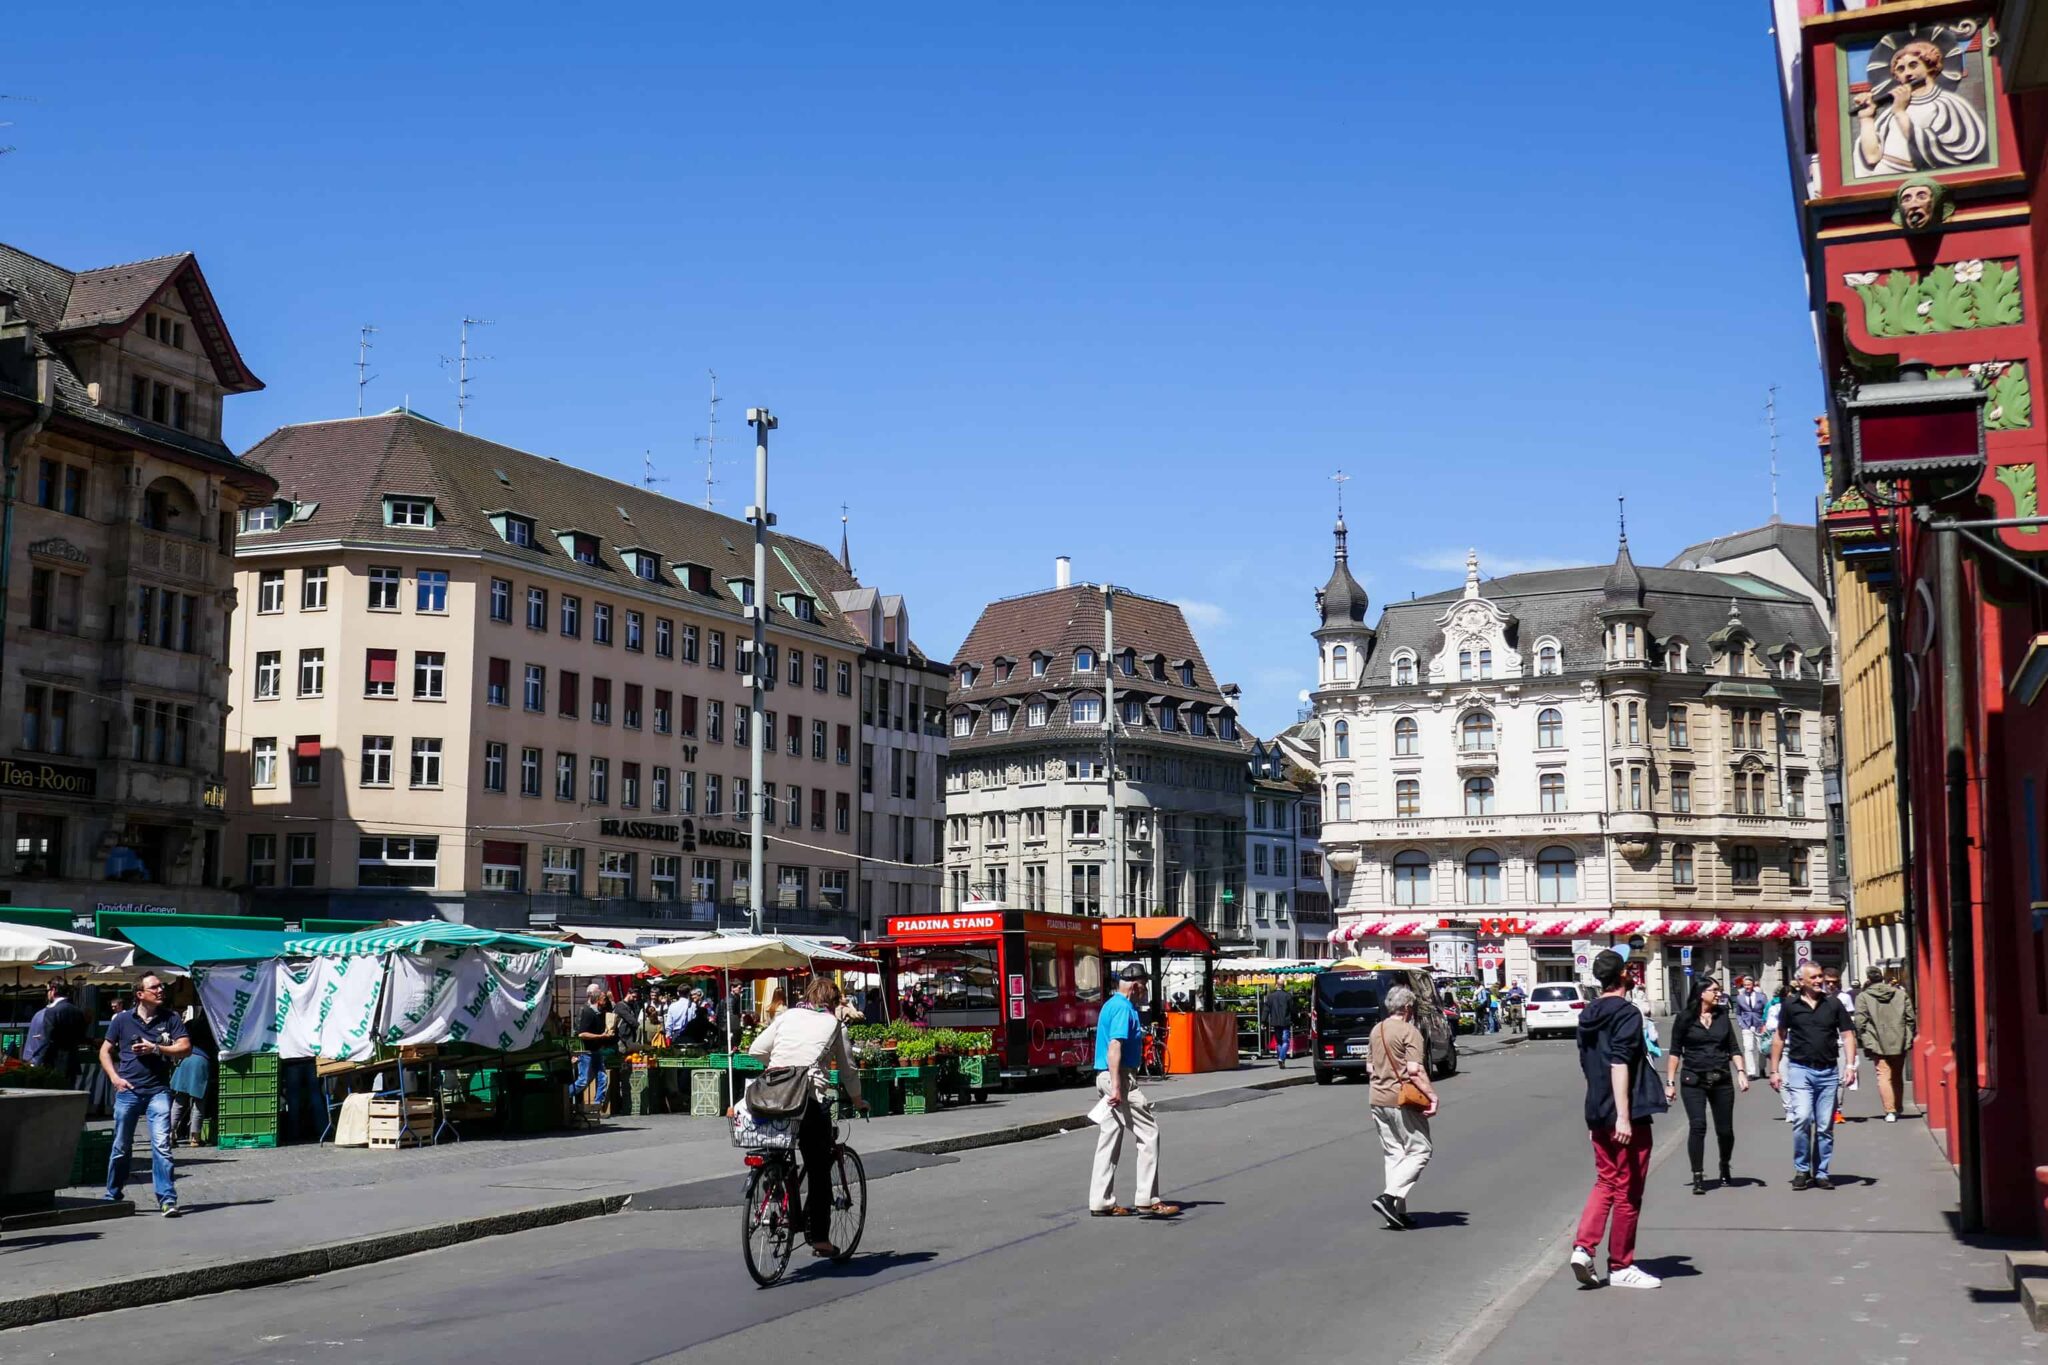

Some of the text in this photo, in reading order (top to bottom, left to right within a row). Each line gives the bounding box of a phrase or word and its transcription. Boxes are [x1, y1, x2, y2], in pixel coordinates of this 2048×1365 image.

[1, 760, 92, 793] Tea-Room
[601, 818, 769, 850] BRASSERIE BASELSTB
[97, 902, 133, 913] Davidoff
[896, 917, 994, 931] PIADINA STAND
[1479, 917, 1527, 935] XXL
